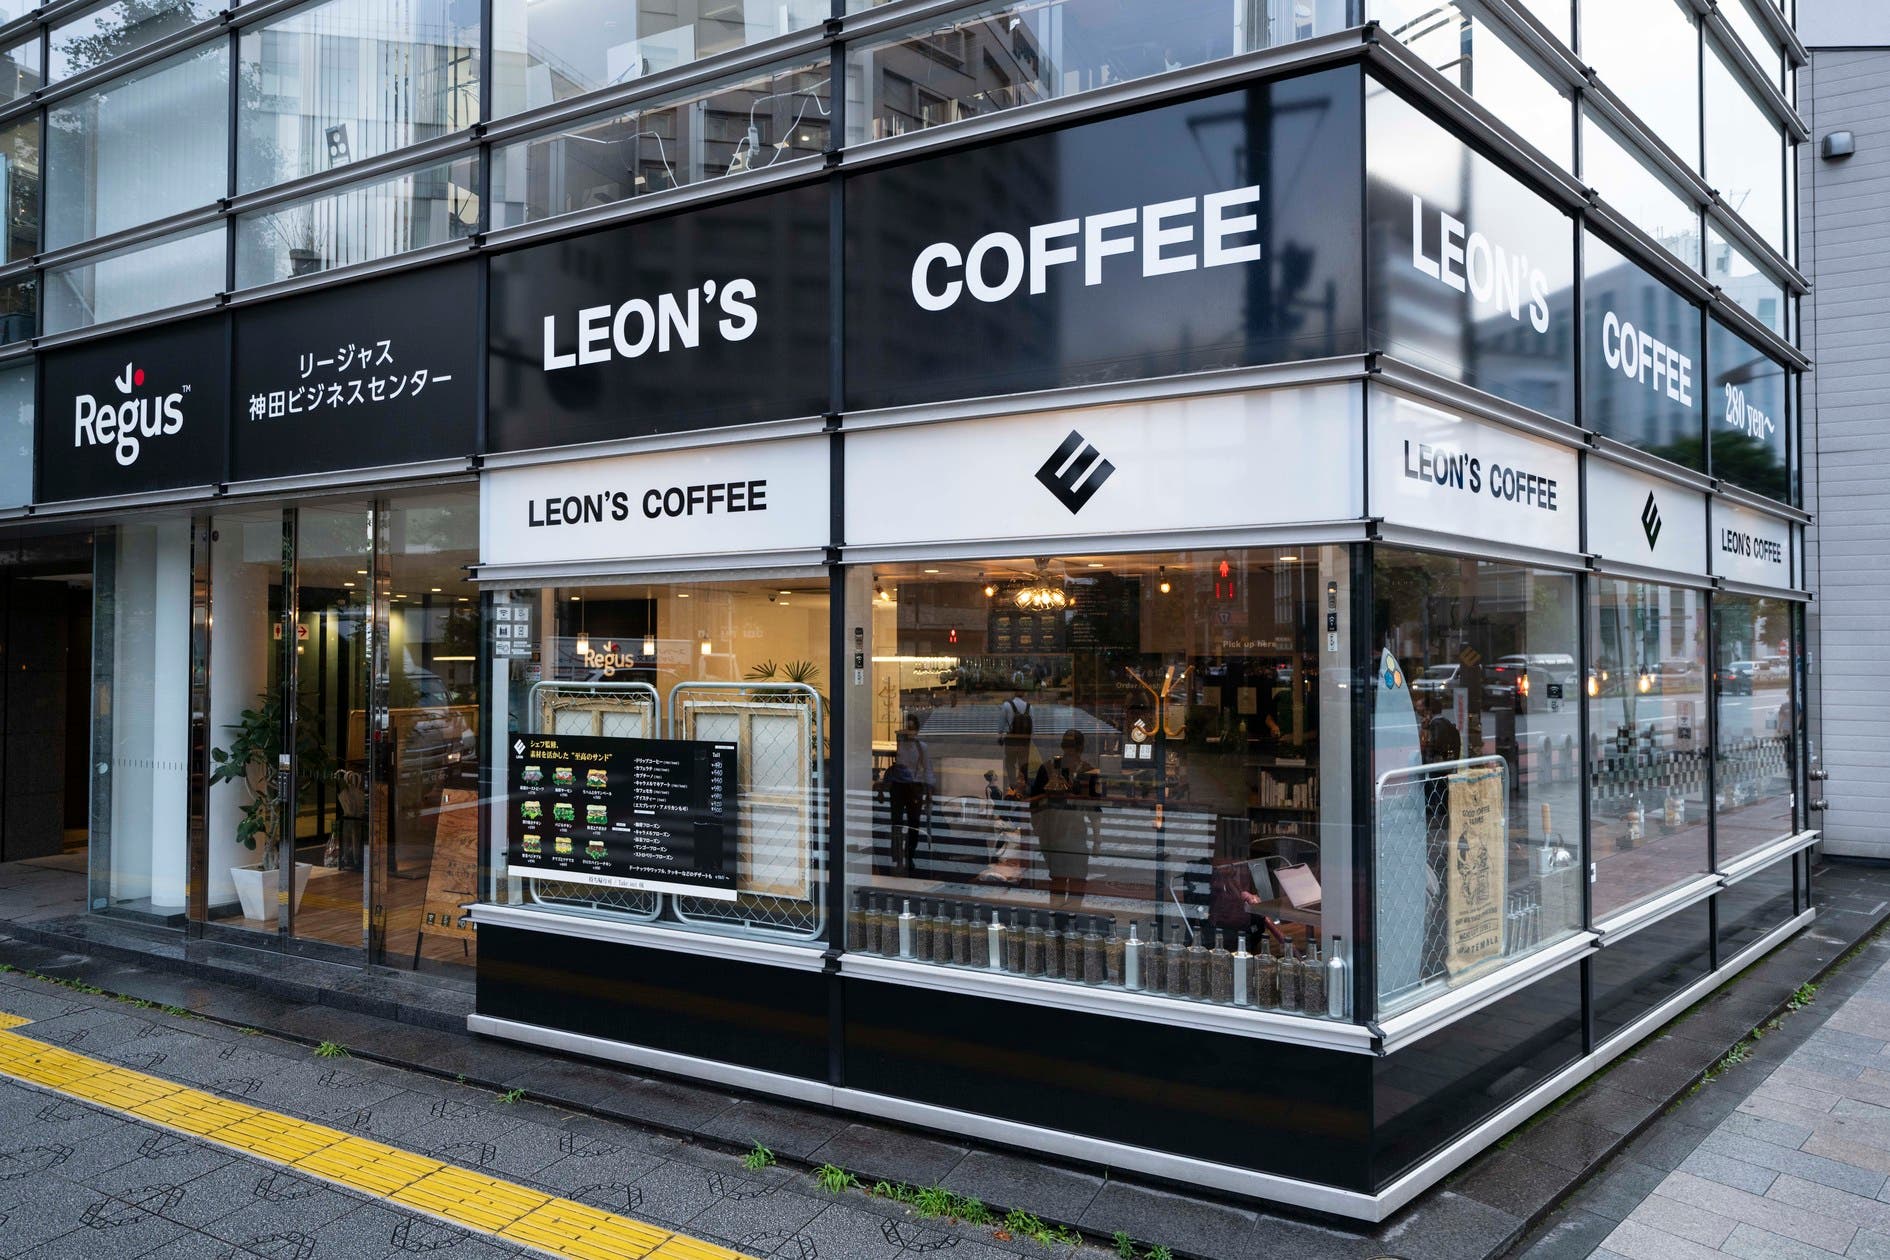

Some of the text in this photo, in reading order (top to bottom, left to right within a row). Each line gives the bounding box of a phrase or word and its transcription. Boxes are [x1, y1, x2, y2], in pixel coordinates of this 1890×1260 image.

[912, 184, 1261, 312] COFFEE
[1412, 194, 1550, 334] LEON'S
[543, 278, 758, 371] LEON'S
[299, 339, 394, 379] リージャス
[1602, 311, 1692, 408] COFFEE
[248, 369, 453, 421] 神田ビジネスセンター
[1725, 381, 1745, 431] 280
[75, 390, 184, 467] Regus
[1403, 439, 1558, 511] LEON'S COFFEE
[528, 479, 767, 527] LEON'S COFFEE
[1721, 527, 1782, 564] LEON'S COFFEE
[584, 648, 634, 678] Regus
[1223, 639, 1241, 649] Pick
[1244, 642, 1255, 651] up
